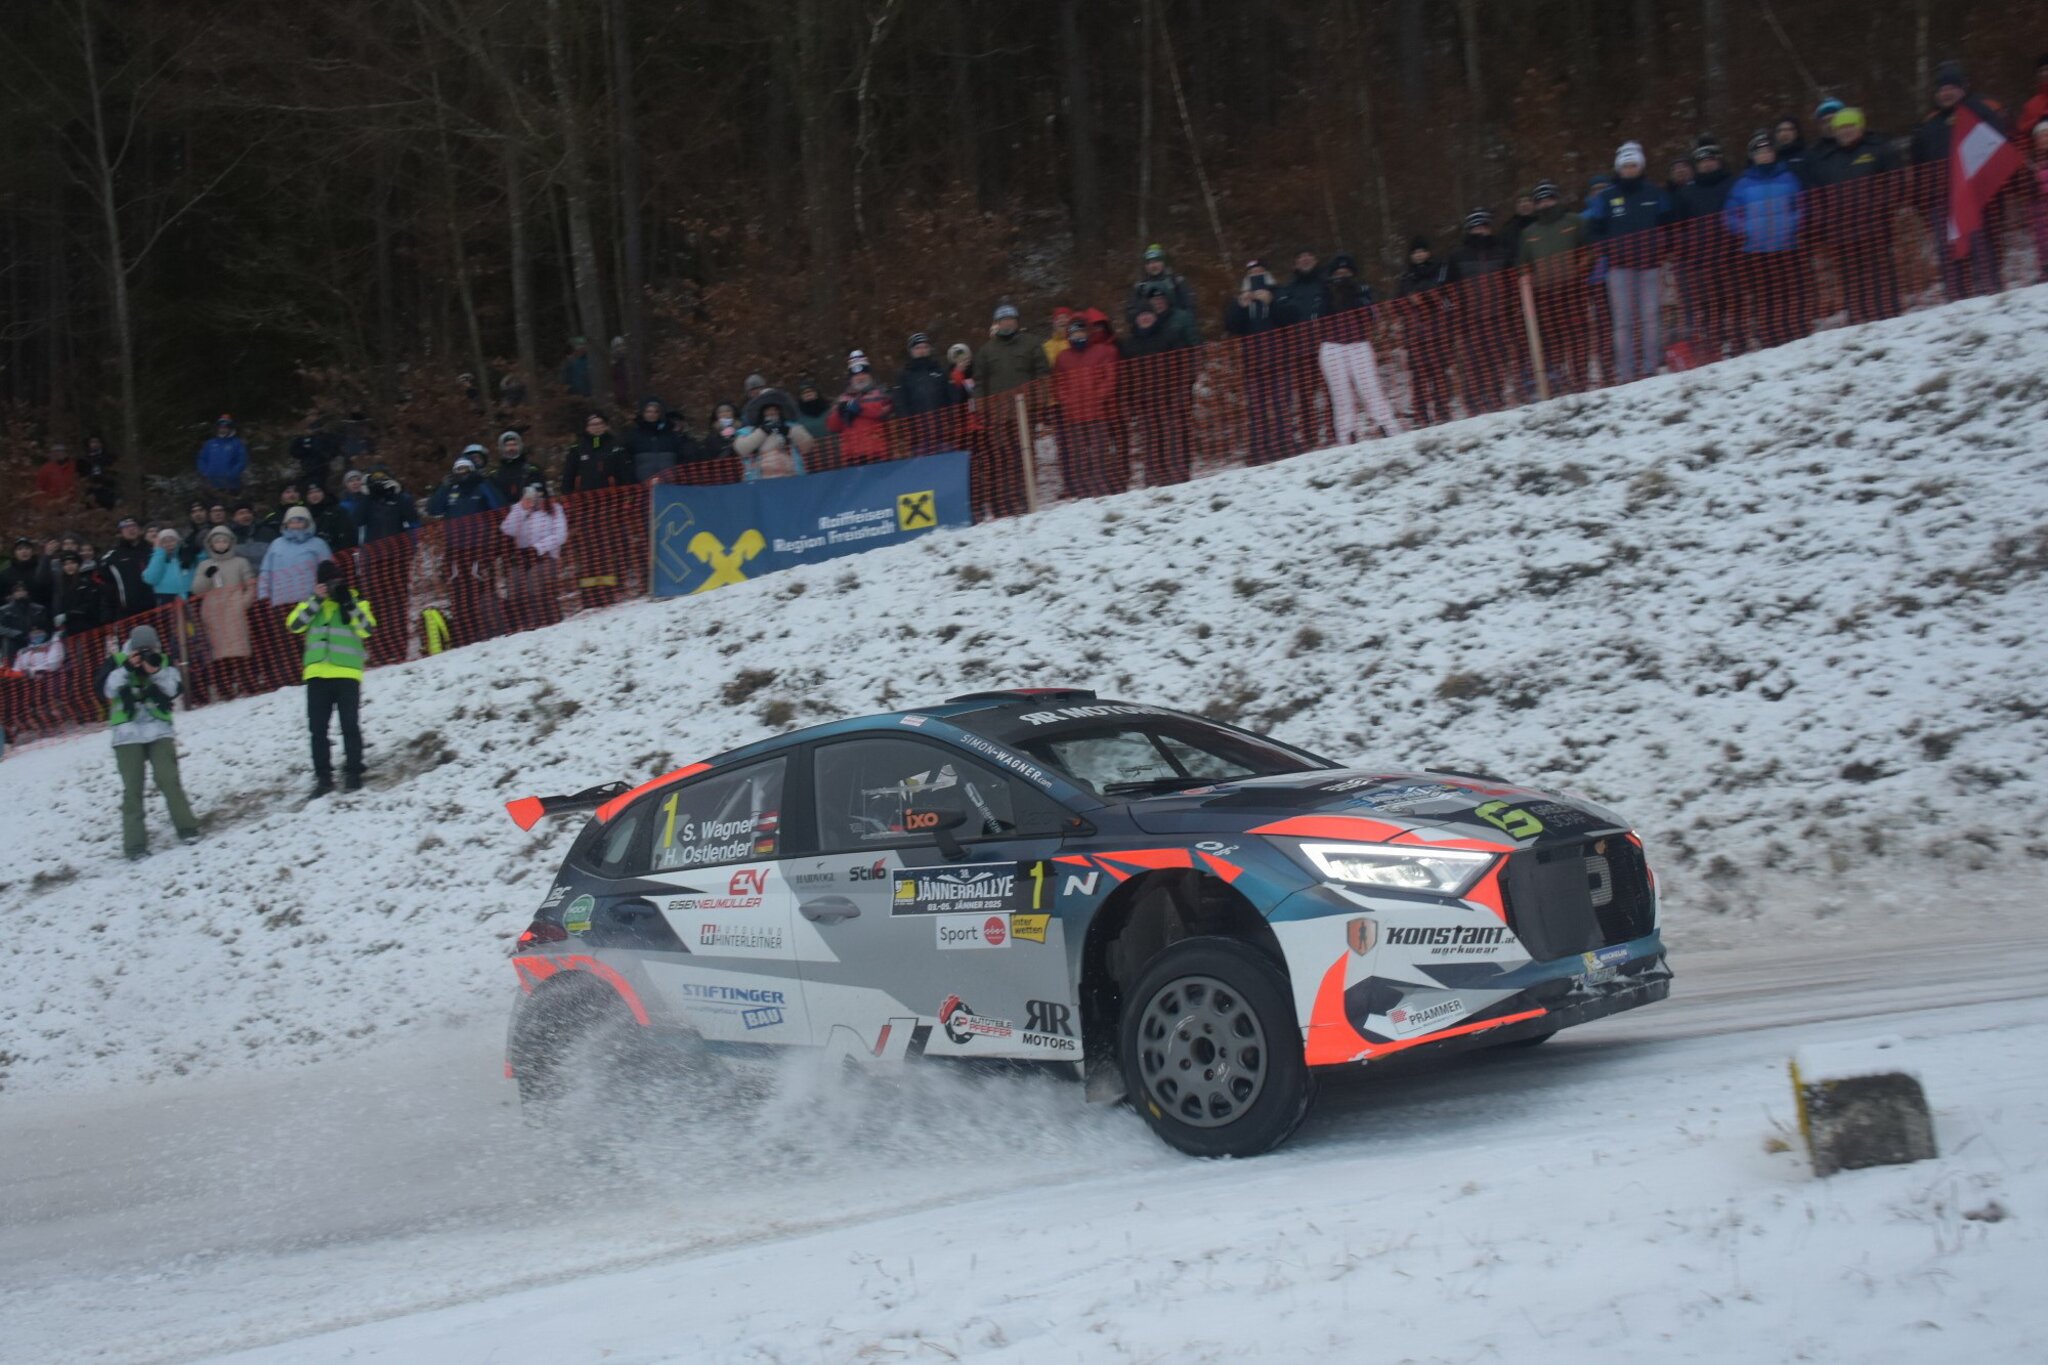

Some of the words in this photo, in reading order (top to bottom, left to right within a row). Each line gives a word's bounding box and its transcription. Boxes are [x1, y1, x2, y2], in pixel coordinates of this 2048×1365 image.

[818, 508, 895, 530] Raiffeisen
[773, 535, 827, 554] Region
[827, 520, 896, 543] Freistadt
[663, 792, 679, 849] 1
[905, 808, 940, 830] ixo
[683, 823, 697, 842] S.
[701, 819, 754, 841] Wagner
[683, 840, 752, 864] Ostlender
[848, 857, 888, 882] Stilo
[917, 875, 1015, 902] JÄNNERRALLYE
[1030, 861, 1045, 910] 1
[954, 900, 983, 911] JÄNNER
[983, 900, 1002, 909] 2025
[716, 934, 783, 949] HINTERLEITNER
[940, 926, 978, 945] Sport
[683, 984, 786, 1005] STIFTINGER
[745, 1008, 781, 1028] BAU
[970, 1016, 1013, 1028] AUTOTEILE
[1409, 999, 1463, 1025] PRAMMER
[969, 1024, 1013, 1037] PFEIFFER
[1022, 1033, 1076, 1051] MOTORS
